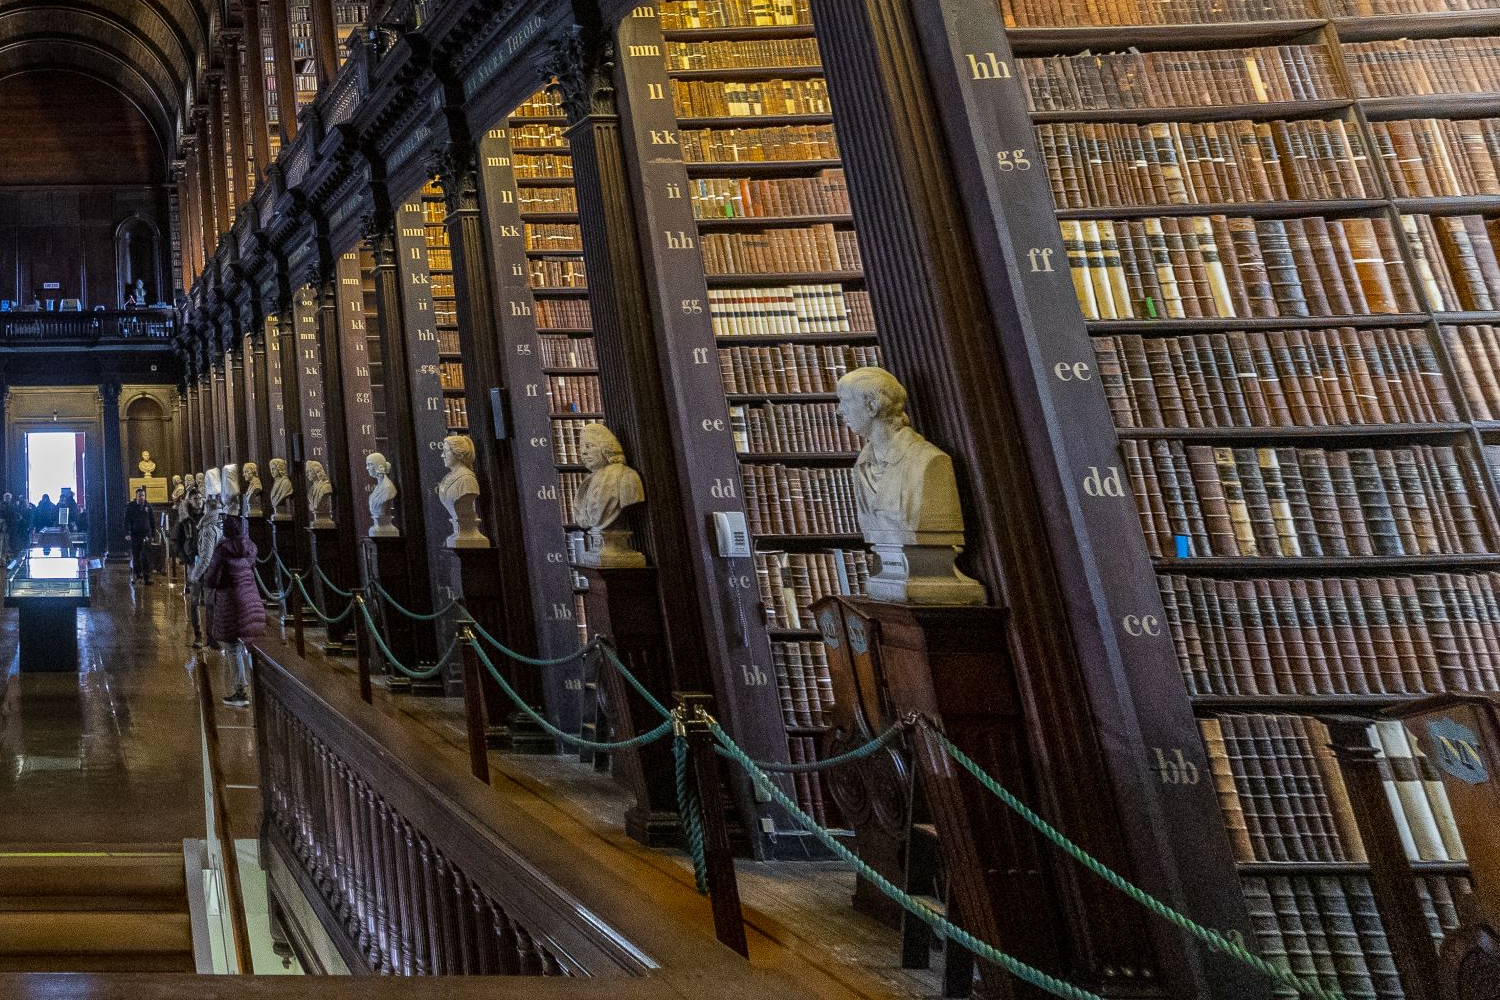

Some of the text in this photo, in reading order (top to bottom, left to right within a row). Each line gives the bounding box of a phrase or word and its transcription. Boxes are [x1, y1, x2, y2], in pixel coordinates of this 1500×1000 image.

[628, 44, 660, 57] mm
[966, 54, 1011, 80] hh
[647, 83, 665, 100] ll
[488, 129, 506, 139] nn
[649, 130, 678, 145] kk
[487, 156, 510, 167] mm
[997, 148, 1031, 171] gg
[501, 191, 514, 204] ll
[666, 183, 681, 199] ii
[404, 203, 420, 212] nn
[402, 227, 425, 237] mm
[500, 225, 521, 237] kk
[665, 231, 695, 250] hh
[410, 248, 421, 260] ll
[1026, 248, 1055, 273] ff
[512, 263, 524, 276] ii
[411, 273, 429, 284] kk
[418, 298, 428, 311] ii
[510, 301, 531, 316] hh
[681, 298, 703, 315] gg
[417, 329, 435, 341] hh
[516, 344, 531, 356] gg
[692, 347, 709, 364] ff
[420, 364, 437, 375] gg
[1053, 359, 1092, 382] ee
[526, 384, 538, 397] ff
[426, 397, 439, 411] ff
[702, 415, 725, 432] ee
[530, 436, 548, 448] ee
[711, 478, 736, 499] dd
[1083, 465, 1125, 499] dd
[537, 485, 557, 500] dd
[546, 552, 564, 563] cc
[1123, 613, 1161, 638] cc
[740, 664, 768, 687] bb
[1155, 747, 1199, 786] bb
